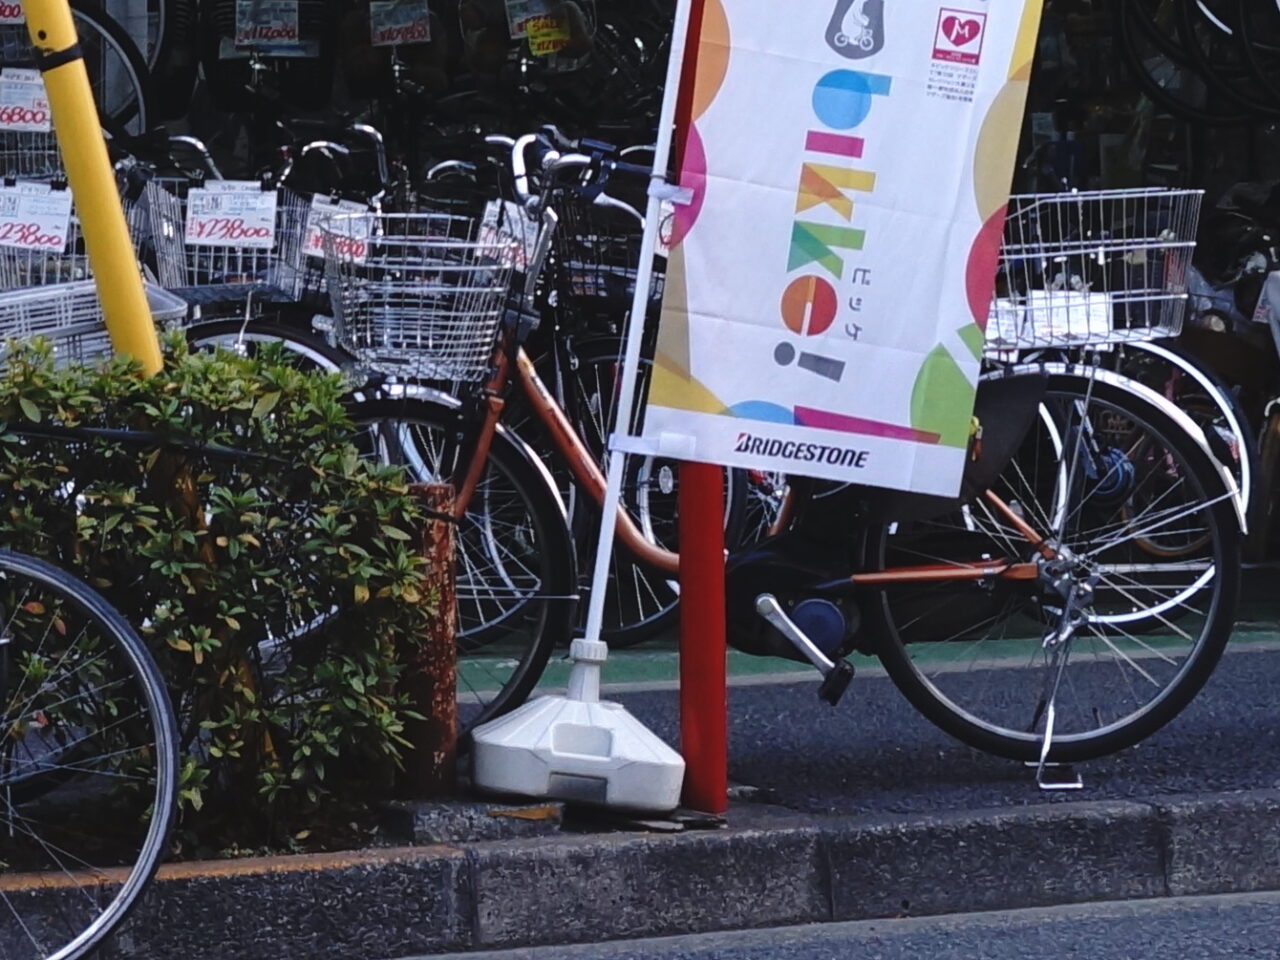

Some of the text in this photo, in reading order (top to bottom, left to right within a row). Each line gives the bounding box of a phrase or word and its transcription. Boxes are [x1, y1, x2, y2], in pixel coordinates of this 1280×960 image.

[845, 266, 873, 341] ビッケ
[734, 431, 871, 469] BRIDGESTONE
